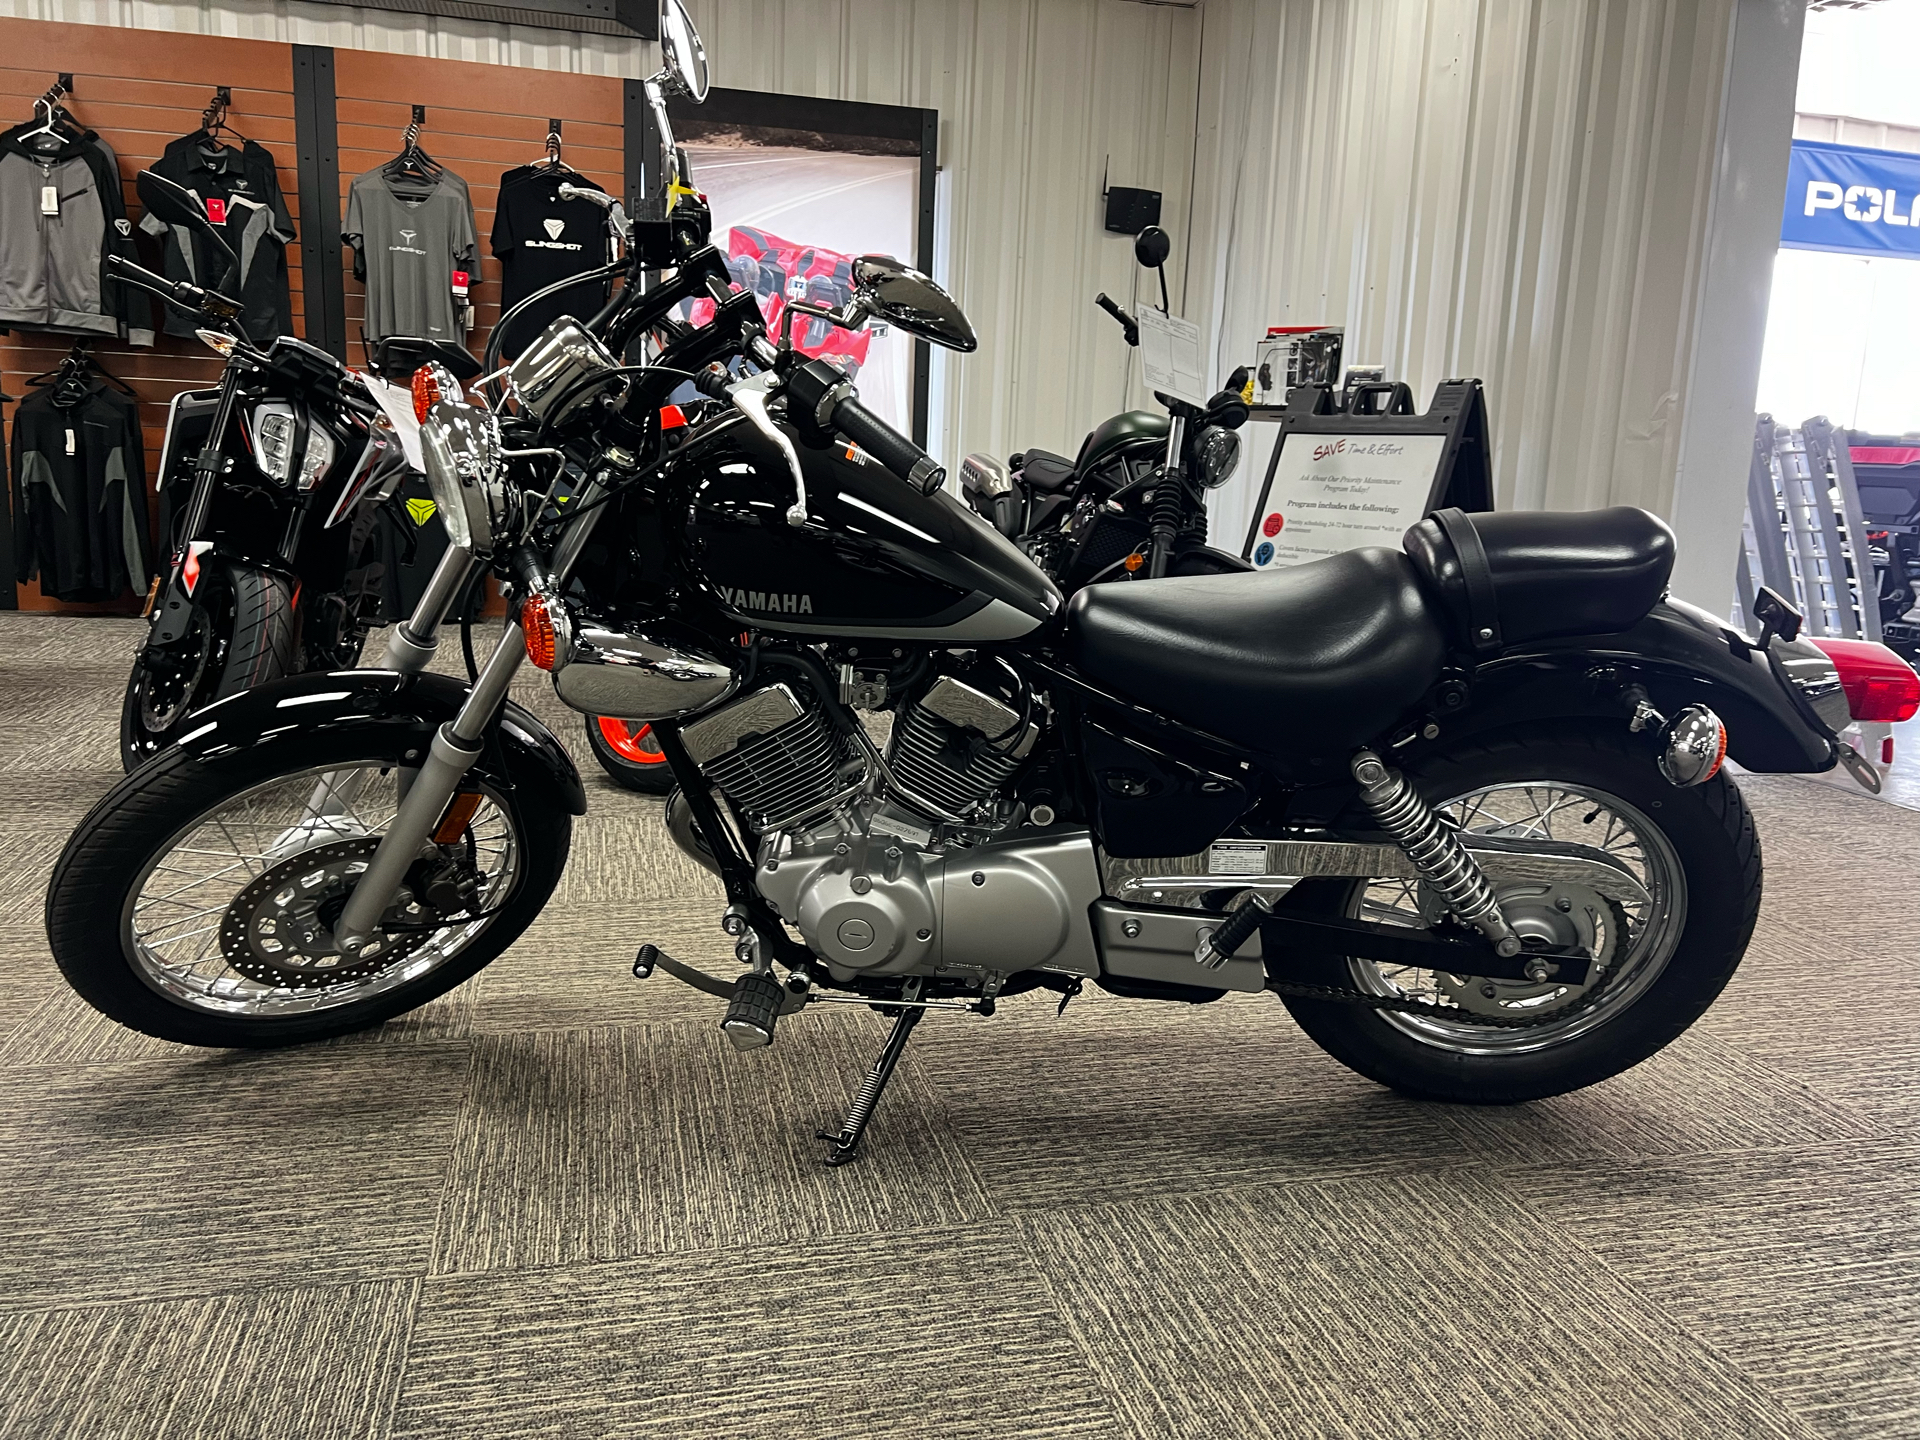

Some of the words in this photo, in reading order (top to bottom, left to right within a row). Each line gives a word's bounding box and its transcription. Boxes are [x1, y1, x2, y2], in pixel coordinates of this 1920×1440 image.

[389, 245, 427, 256] SLINGSHOT
[525, 240, 583, 251] SLINGSHOT
[1312, 438, 1347, 461] SAVE
[1348, 443, 1366, 455] Time
[1367, 443, 1376, 456] &
[1377, 443, 1404, 456] Effort
[1328, 475, 1340, 483] Our
[1340, 476, 1363, 486] Priority
[1363, 477, 1402, 486] Maintenance
[1323, 484, 1349, 494] Program
[1349, 485, 1371, 495] Today!
[1287, 499, 1318, 509] Program
[1318, 501, 1348, 511] includes
[1348, 503, 1361, 512] the
[1361, 503, 1400, 515] following:
[720, 585, 813, 614] YAMAHA
